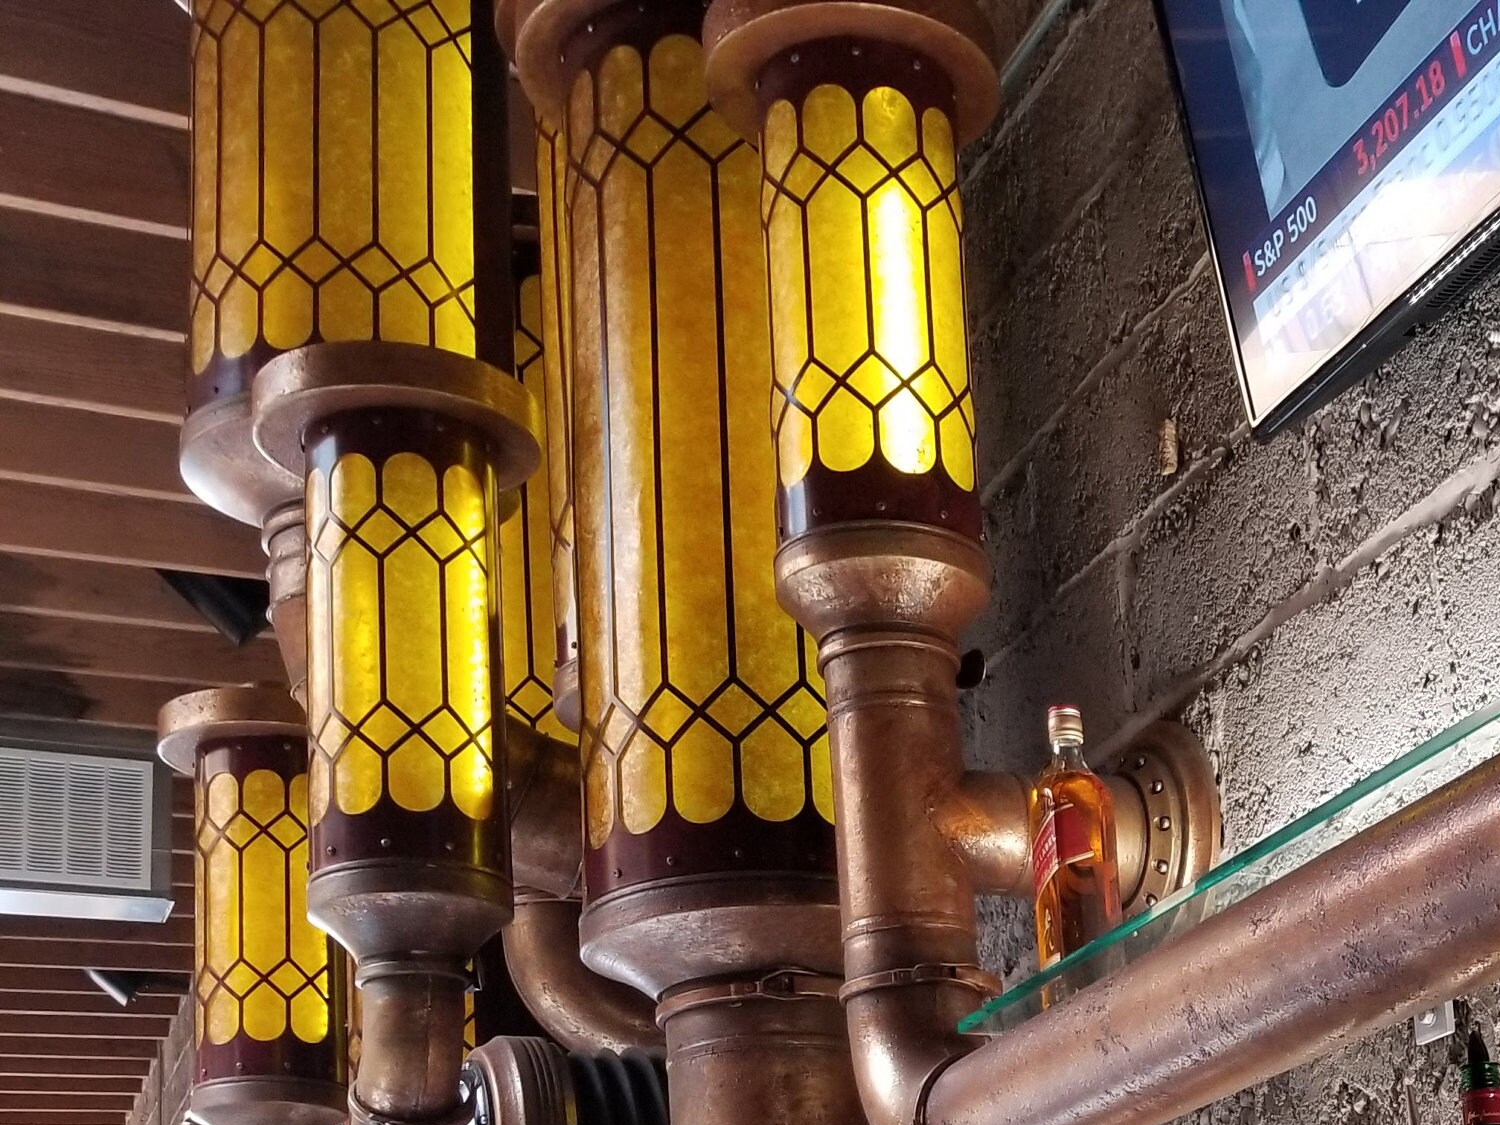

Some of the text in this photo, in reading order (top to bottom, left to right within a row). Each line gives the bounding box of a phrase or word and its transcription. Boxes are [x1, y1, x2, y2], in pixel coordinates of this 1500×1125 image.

[1352, 60, 1447, 176] 3,207.18
[1253, 196, 1317, 277] S&P 500
